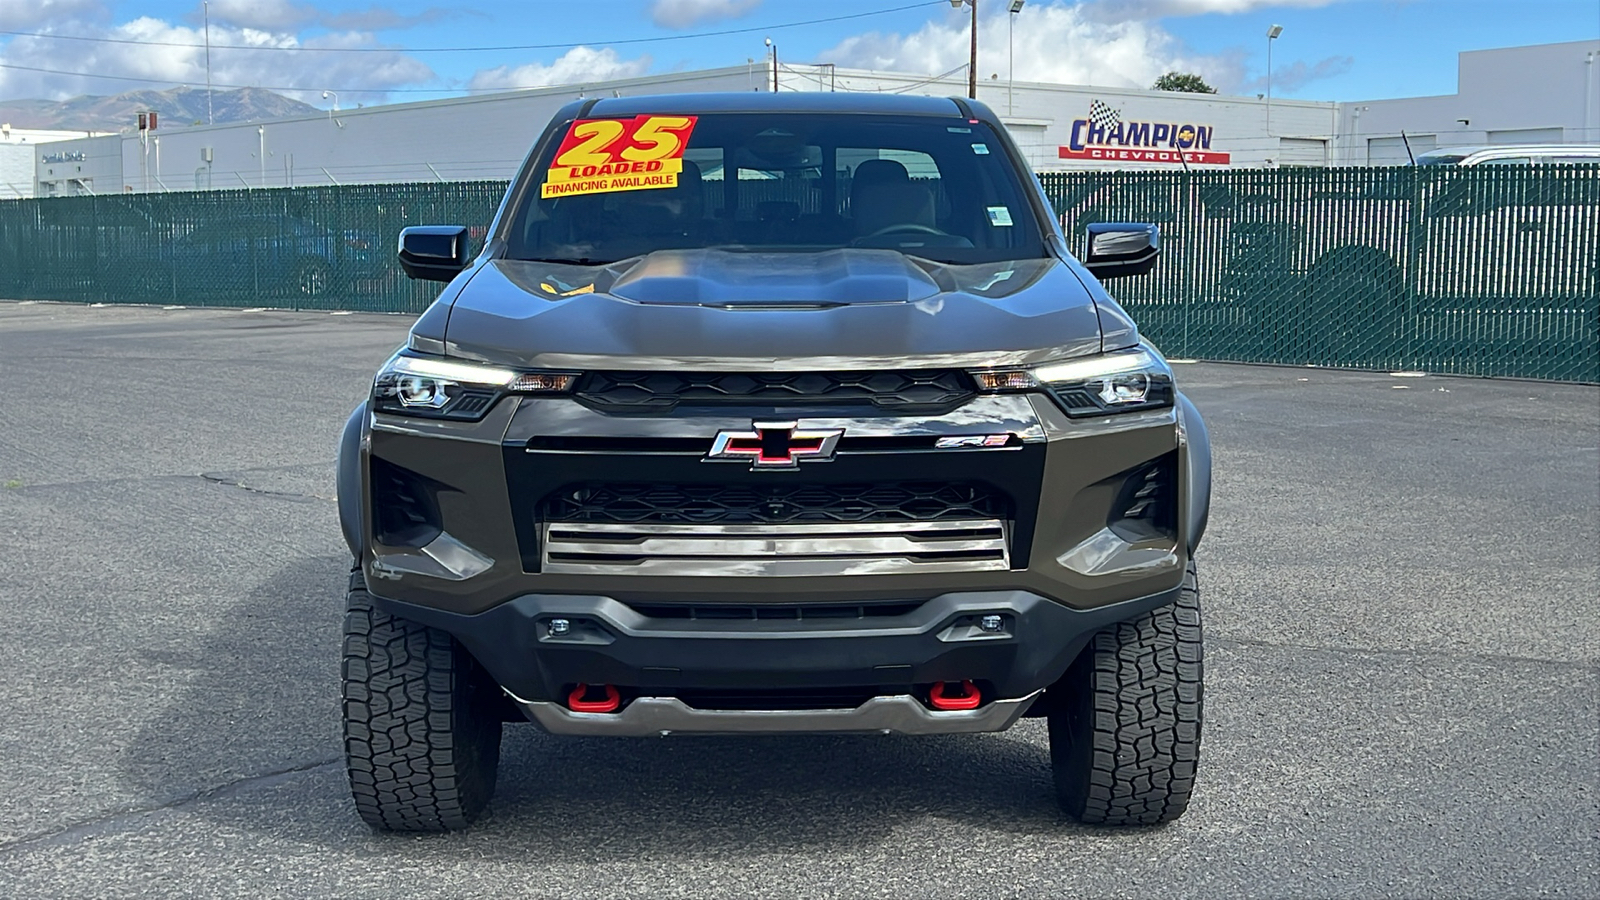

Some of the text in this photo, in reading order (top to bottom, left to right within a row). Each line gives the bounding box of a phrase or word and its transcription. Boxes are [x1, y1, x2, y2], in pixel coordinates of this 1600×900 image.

[556, 116, 692, 166] 25
[1069, 119, 1213, 151] CHAMPION
[1091, 150, 1206, 162] CHEVROLET
[569, 160, 663, 178] LOADED
[545, 175, 674, 195] FINANCING AVAILABLE
